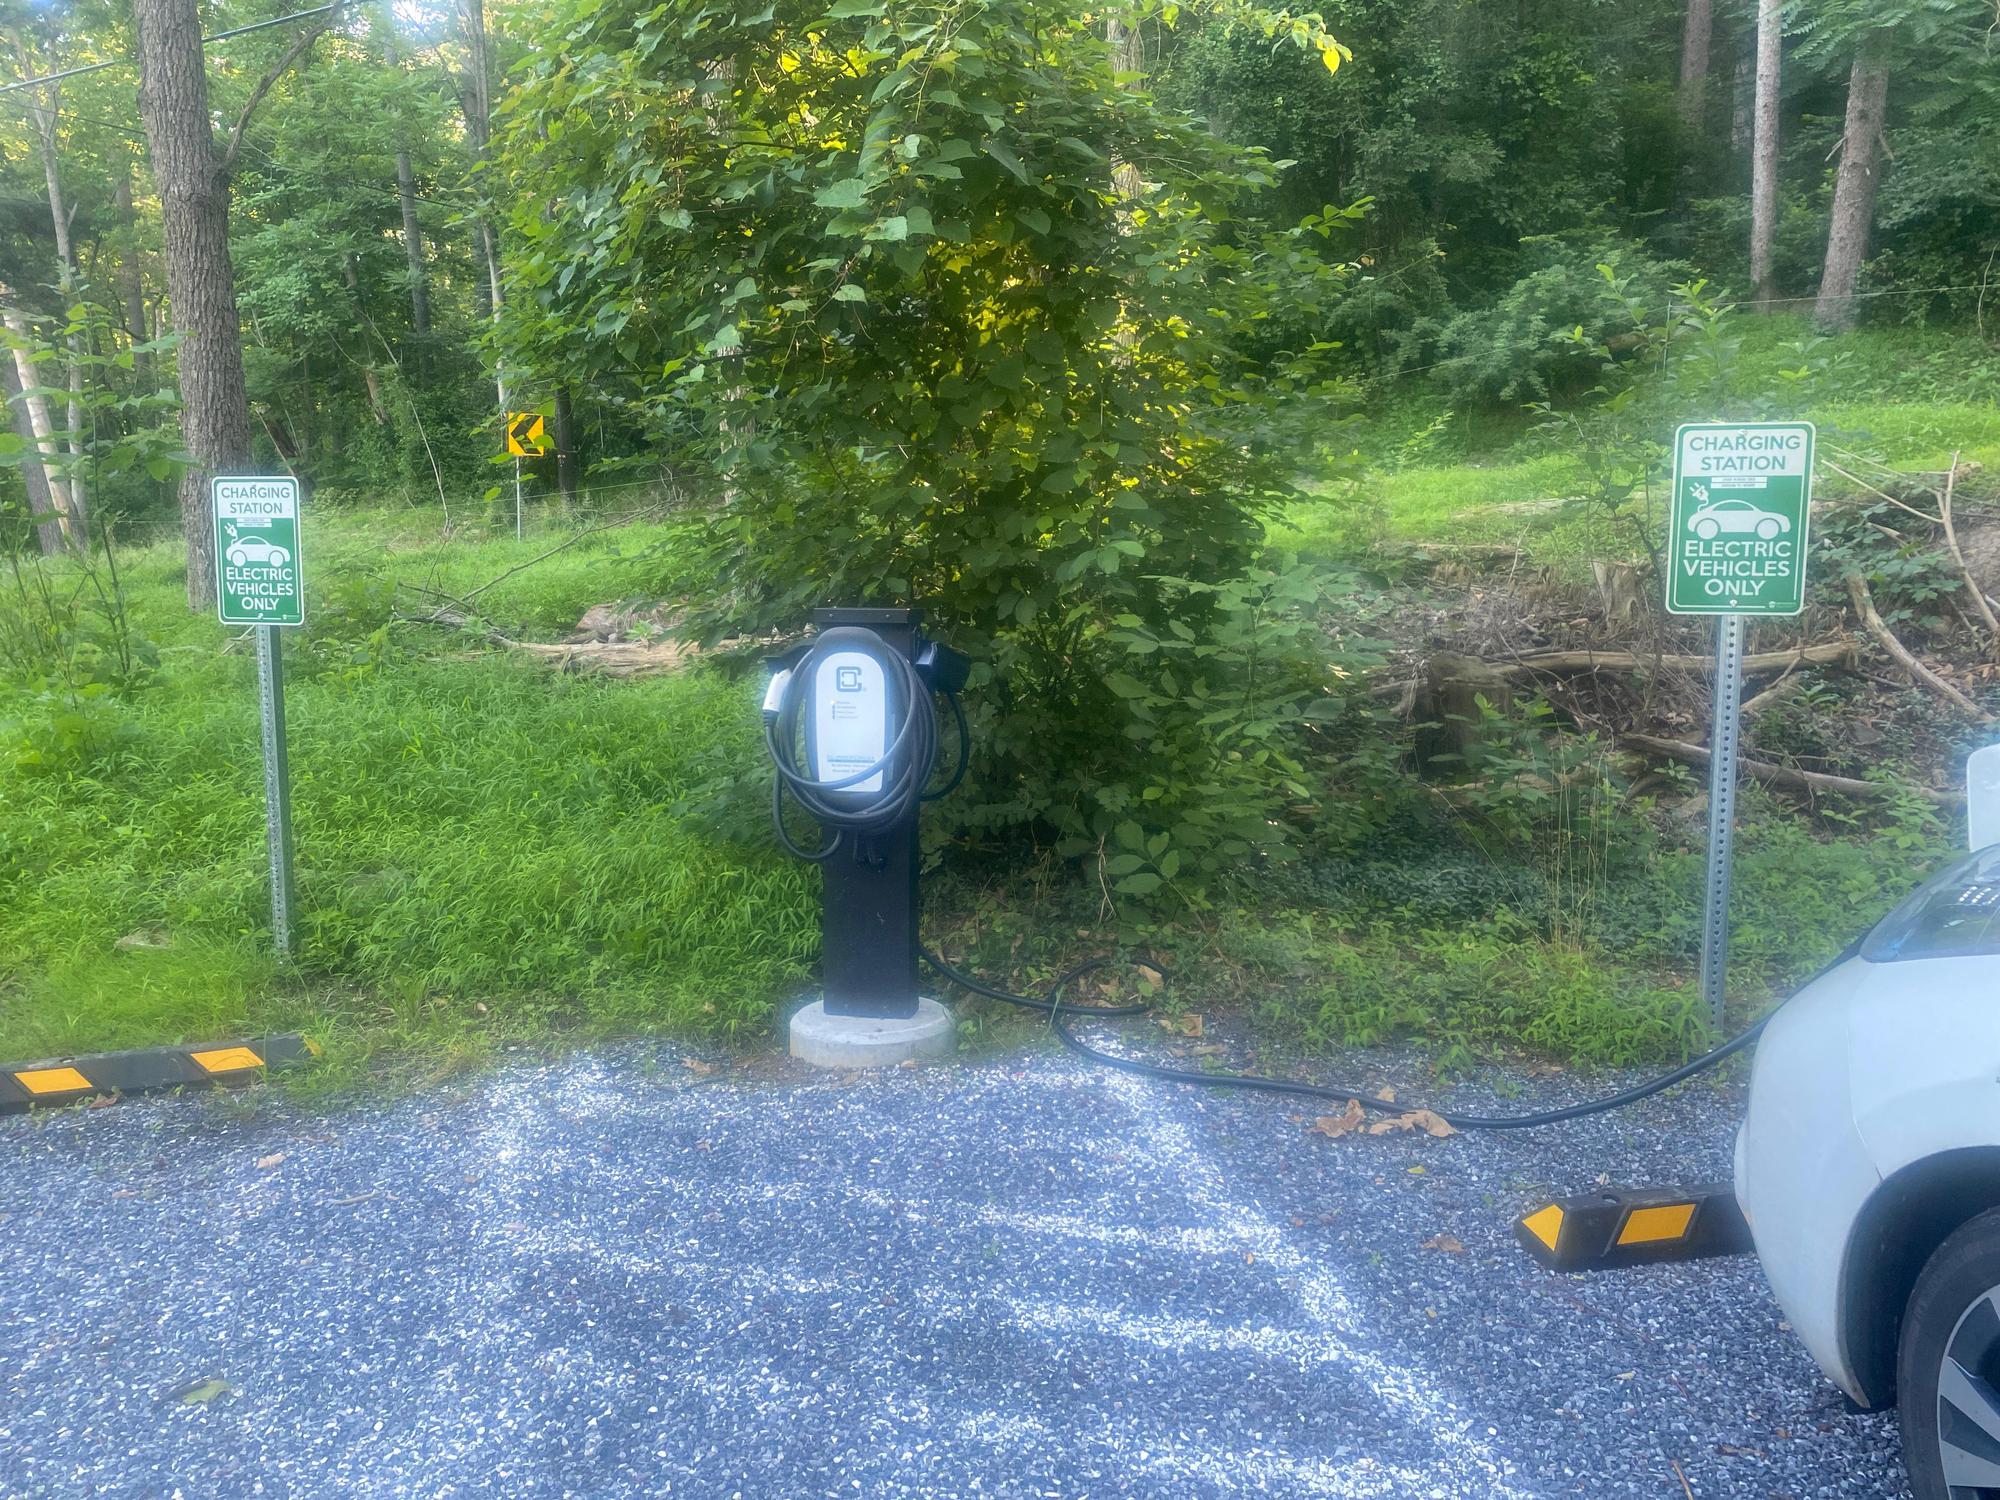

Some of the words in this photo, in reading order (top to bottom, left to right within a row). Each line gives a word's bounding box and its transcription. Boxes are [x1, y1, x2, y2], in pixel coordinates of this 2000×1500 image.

[1689, 435, 1801, 451] CHARGING
[1701, 455, 1786, 471] STATION
[221, 487, 290, 499] CHARGING
[230, 502, 283, 514] STATION
[1684, 540, 1792, 557] ELECTRIC
[226, 567, 293, 580] ELECTRIC
[1683, 559, 1790, 577] VEHICLES
[226, 582, 294, 596] VEHICLES
[1704, 578, 1766, 596] ONLY
[241, 597, 280, 610] ONLY
